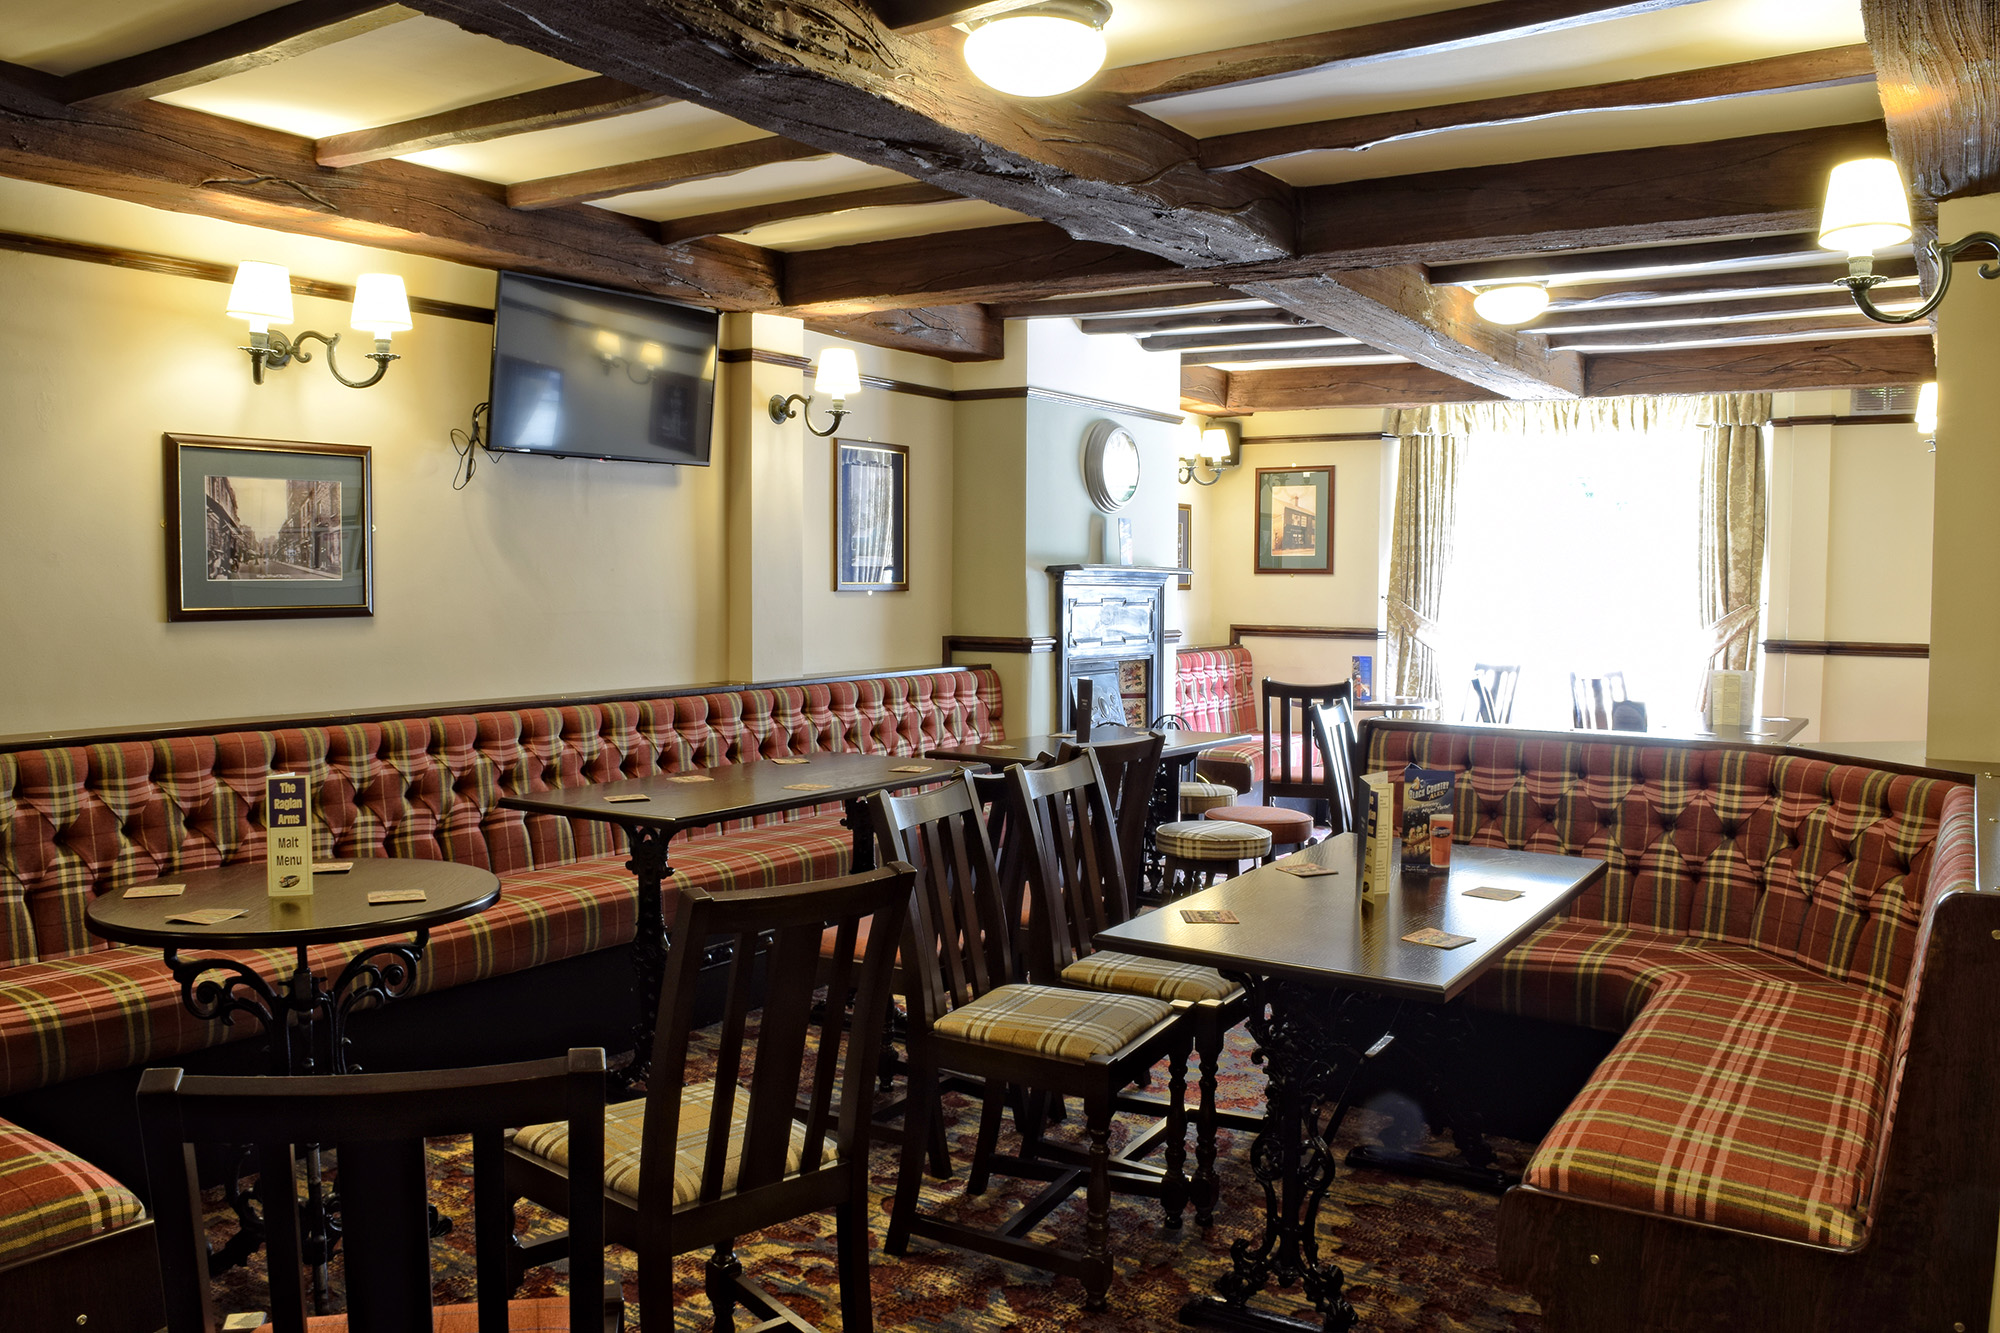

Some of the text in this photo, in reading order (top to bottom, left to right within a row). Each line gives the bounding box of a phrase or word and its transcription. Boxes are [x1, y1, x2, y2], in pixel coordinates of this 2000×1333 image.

[280, 782, 296, 793] The
[274, 797, 302, 810] Raglan
[278, 814, 300, 824] Arms
[278, 837, 299, 849] Malt
[276, 855, 302, 866] Menu
